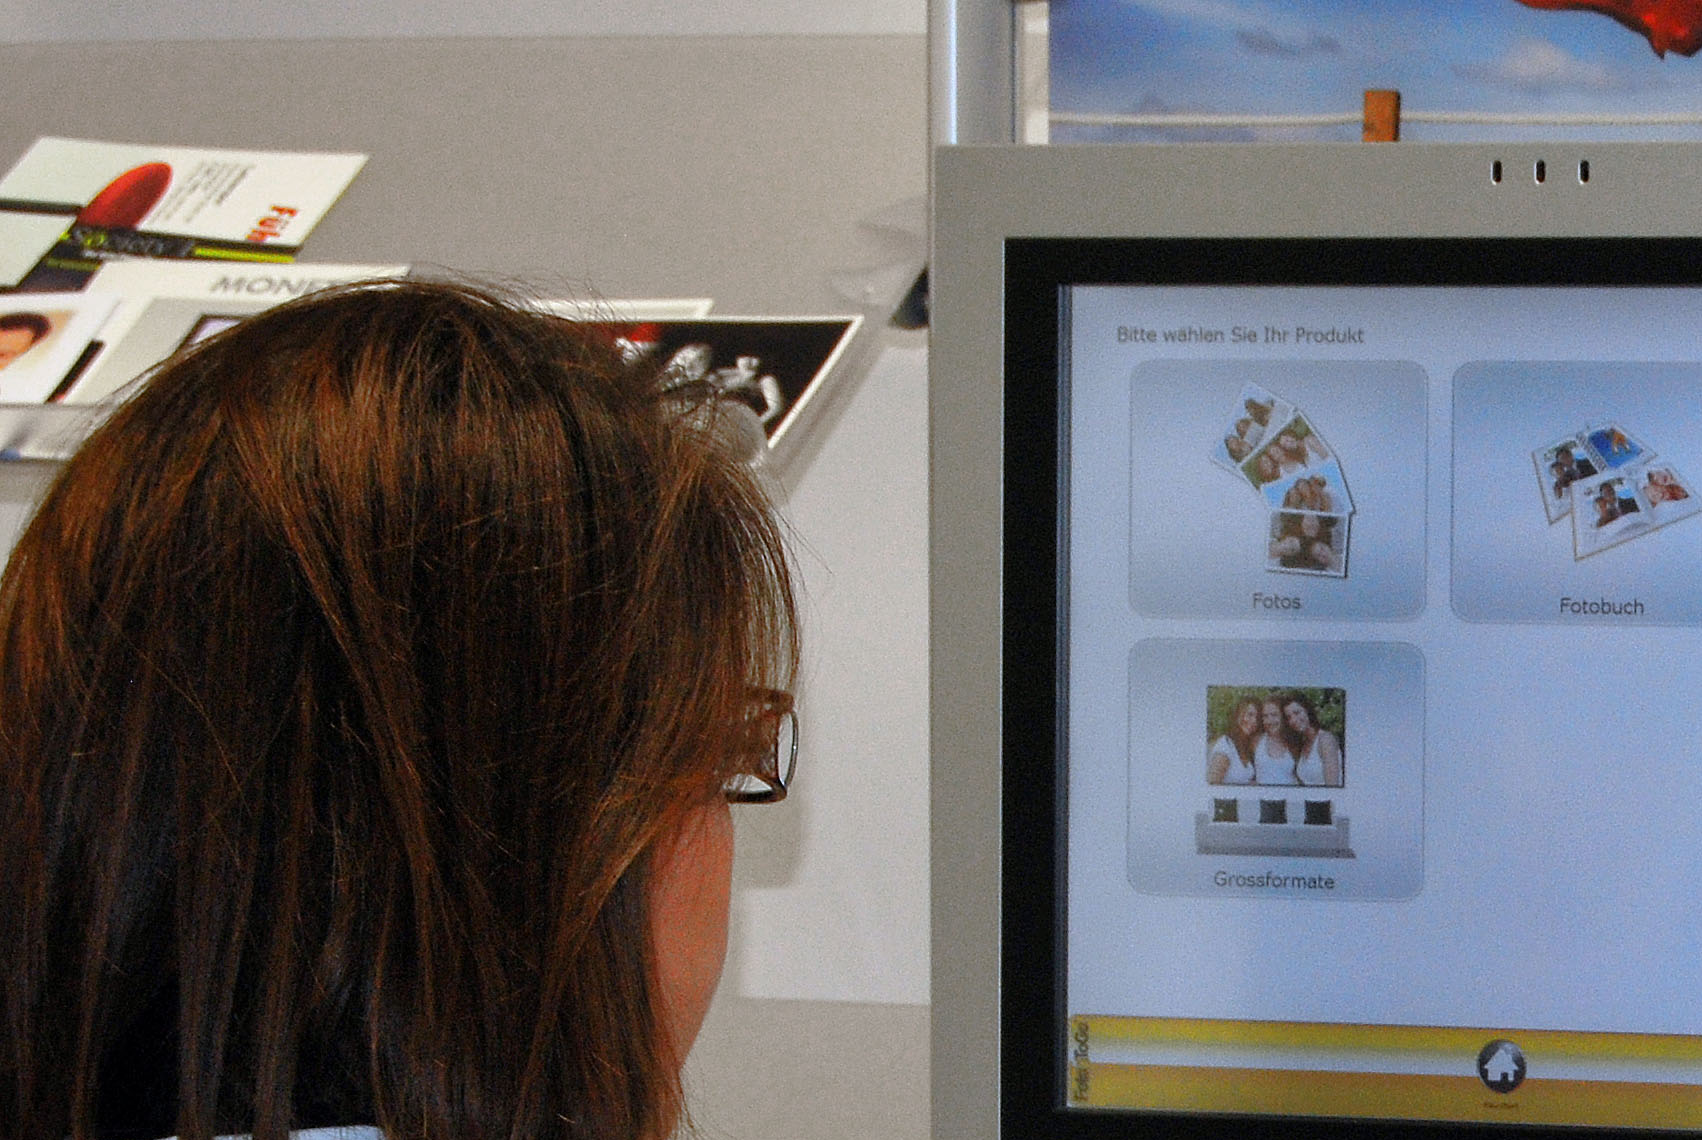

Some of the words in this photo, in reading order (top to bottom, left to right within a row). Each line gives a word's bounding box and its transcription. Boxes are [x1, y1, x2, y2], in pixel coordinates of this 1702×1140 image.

[1117, 326, 1157, 343] Bitte
[1231, 327, 1257, 343] Sie
[1264, 327, 1290, 344] Ihr
[1296, 327, 1365, 345] Produkt
[1252, 593, 1303, 610] Fotos
[1560, 598, 1645, 617] Fotobuch
[1213, 870, 1336, 891] Grossformate
